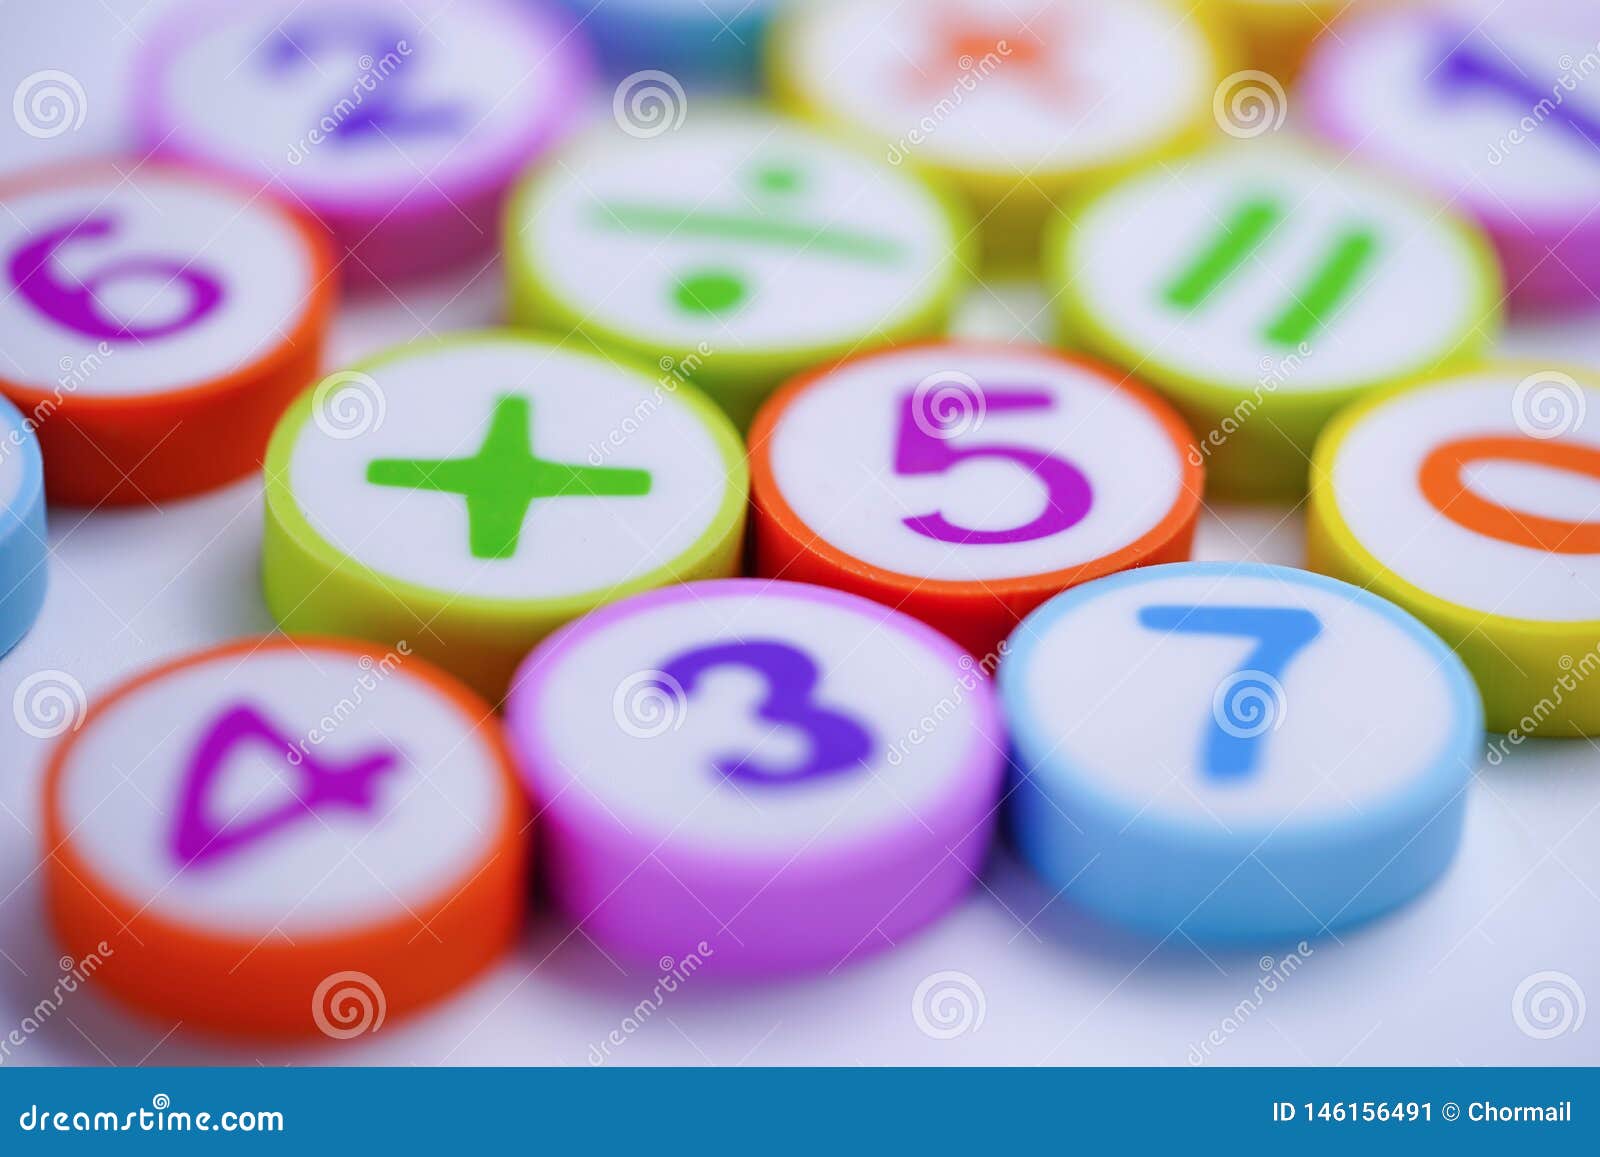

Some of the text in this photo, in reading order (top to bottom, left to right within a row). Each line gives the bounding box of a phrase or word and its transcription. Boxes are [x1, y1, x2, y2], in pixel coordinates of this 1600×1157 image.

[262, 14, 468, 150] 2
[6, 211, 230, 347] 6
[891, 386, 1096, 547] 5
[650, 637, 881, 792] 3
[1135, 603, 1324, 789] 7
[163, 700, 402, 874] 4
